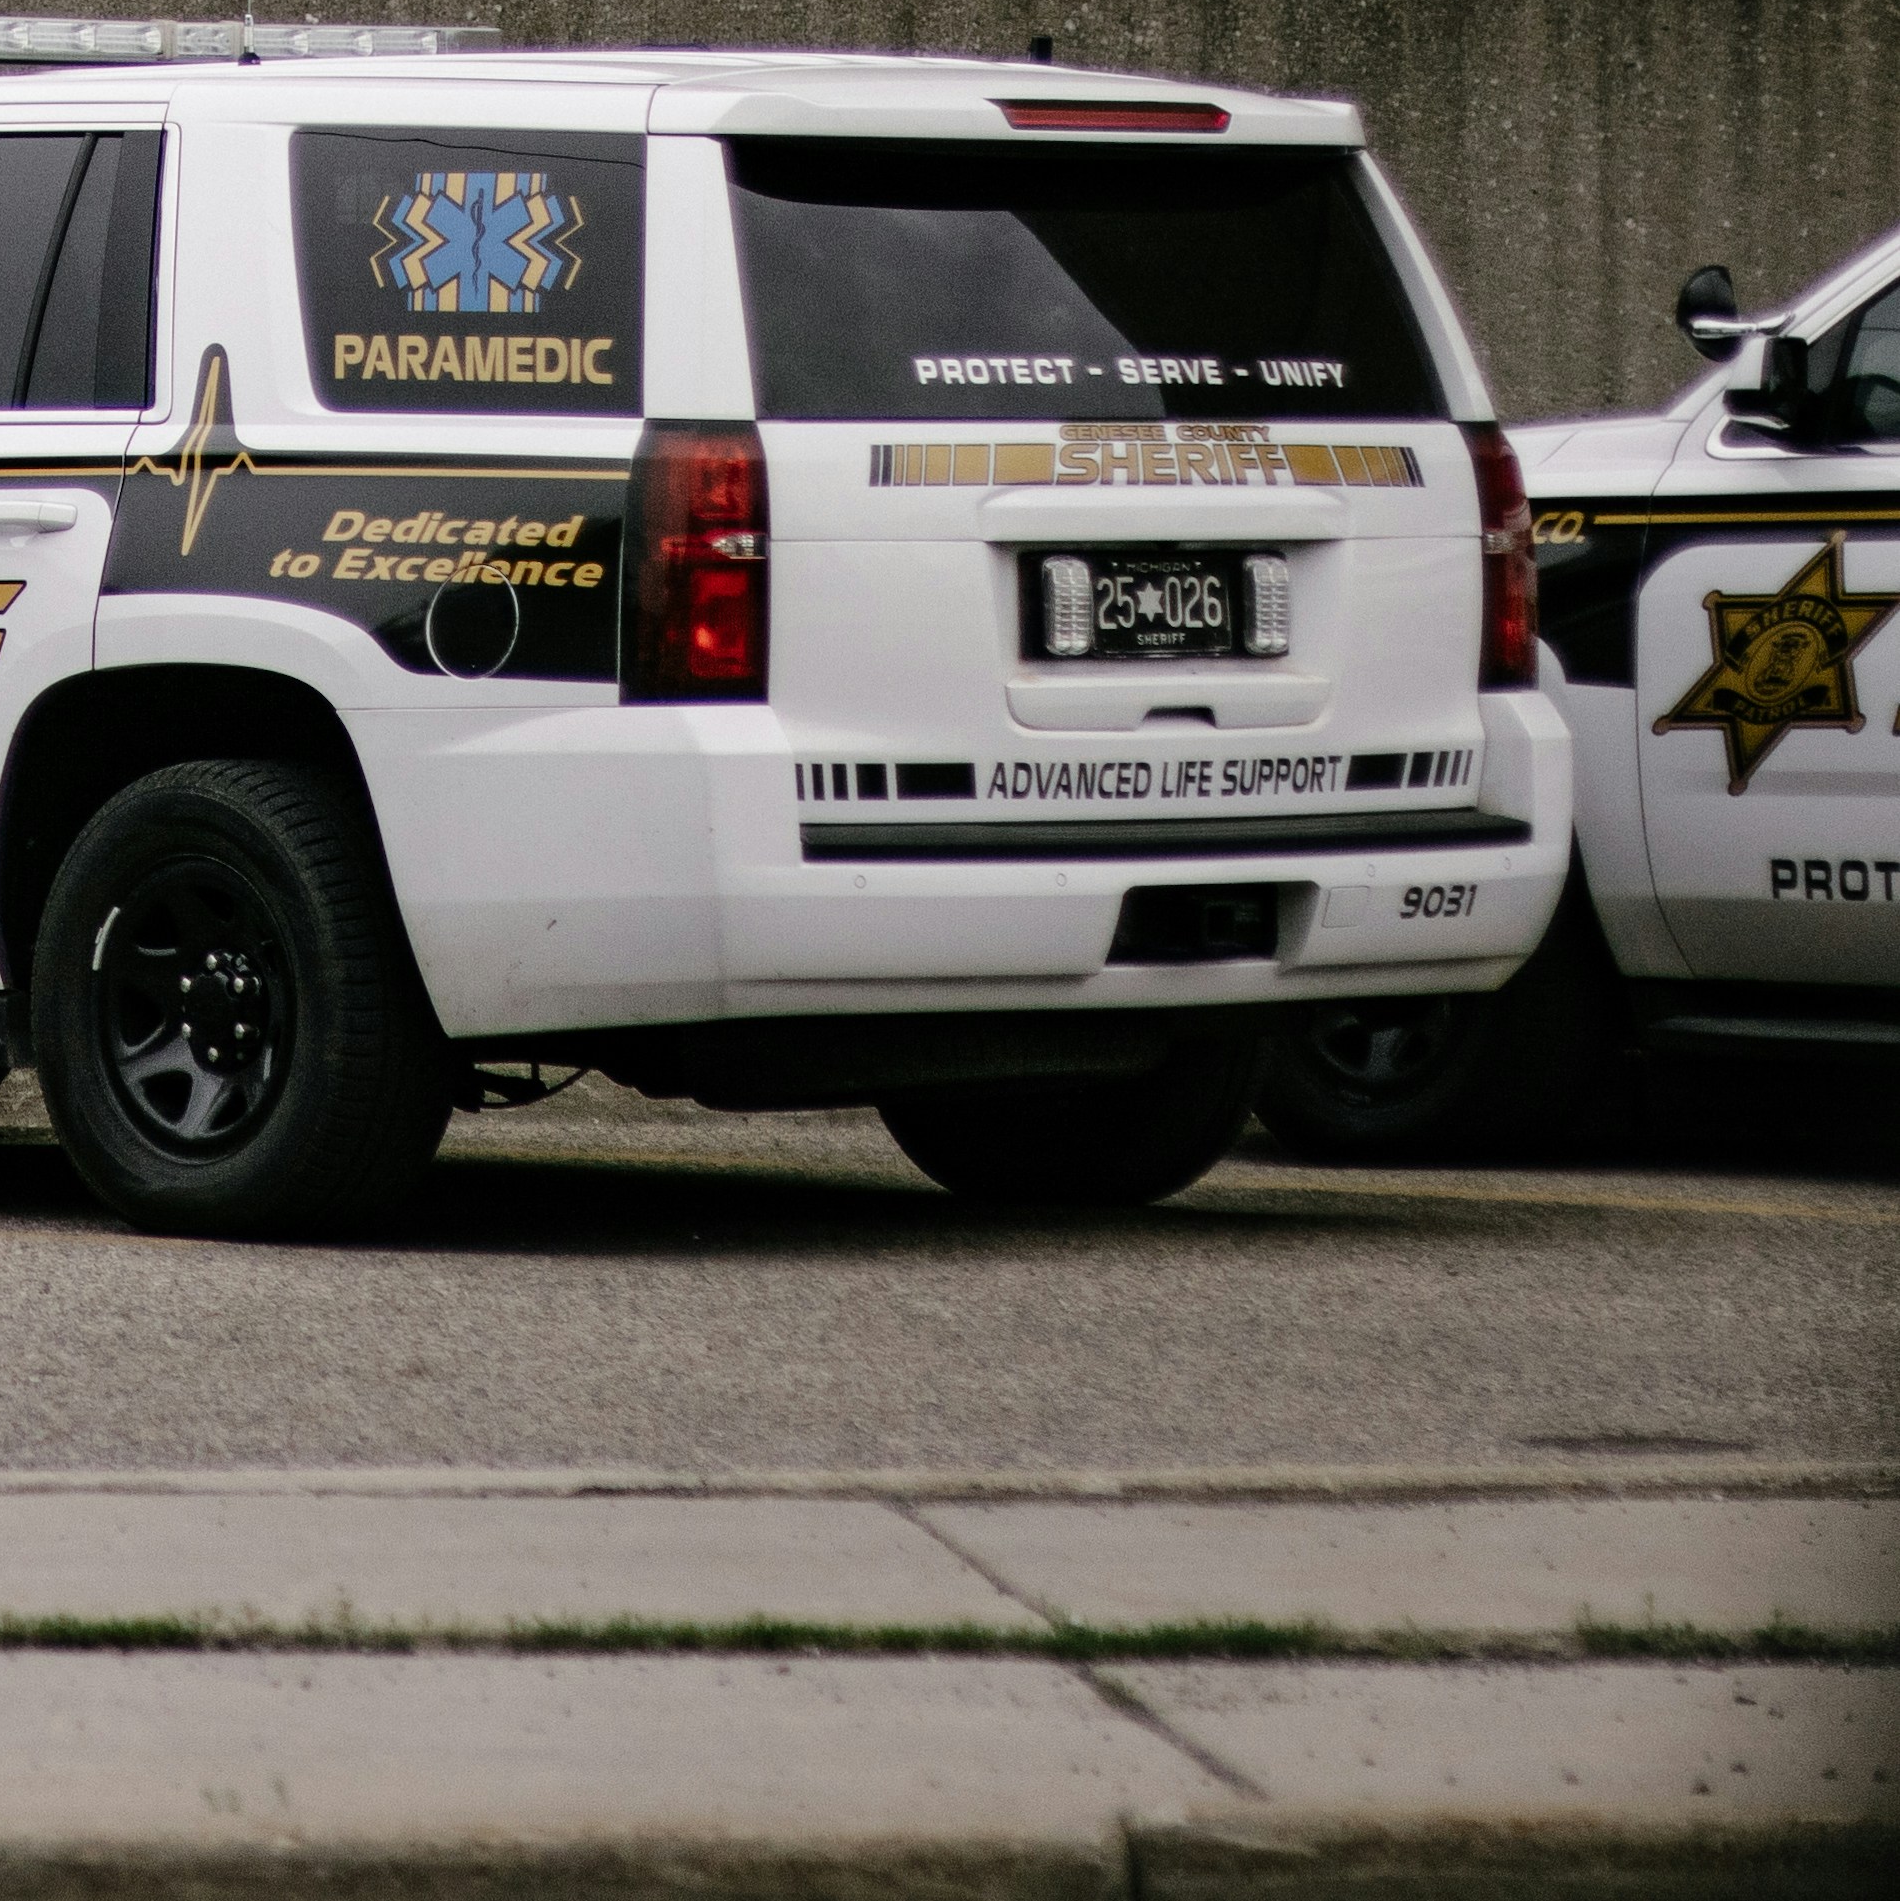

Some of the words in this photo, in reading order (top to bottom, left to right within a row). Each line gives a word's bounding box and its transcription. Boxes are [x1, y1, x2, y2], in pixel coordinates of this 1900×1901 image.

[334, 334, 614, 384] PARAMEDIC
[915, 358, 1075, 385] PROTECT
[1117, 358, 1224, 385] SERVE
[1258, 360, 1344, 388] UNIFY
[1059, 425, 1166, 442] GENESEE
[1176, 425, 1270, 442] COUNTY
[1054, 443, 1287, 486] SHERIFF
[322, 510, 586, 547] Dedicated
[269, 548, 321, 578] to
[333, 548, 604, 588] Excellence
[1097, 577, 1135, 629] 25
[1165, 576, 1222, 628] 026
[1745, 600, 1842, 635] SHERIFF
[1137, 633, 1186, 645] SHERIFF
[987, 761, 1152, 800] ADVANCED
[1160, 760, 1213, 798] LIFE
[1220, 755, 1344, 797] SUPPORT
[1399, 884, 1478, 919] 9031
